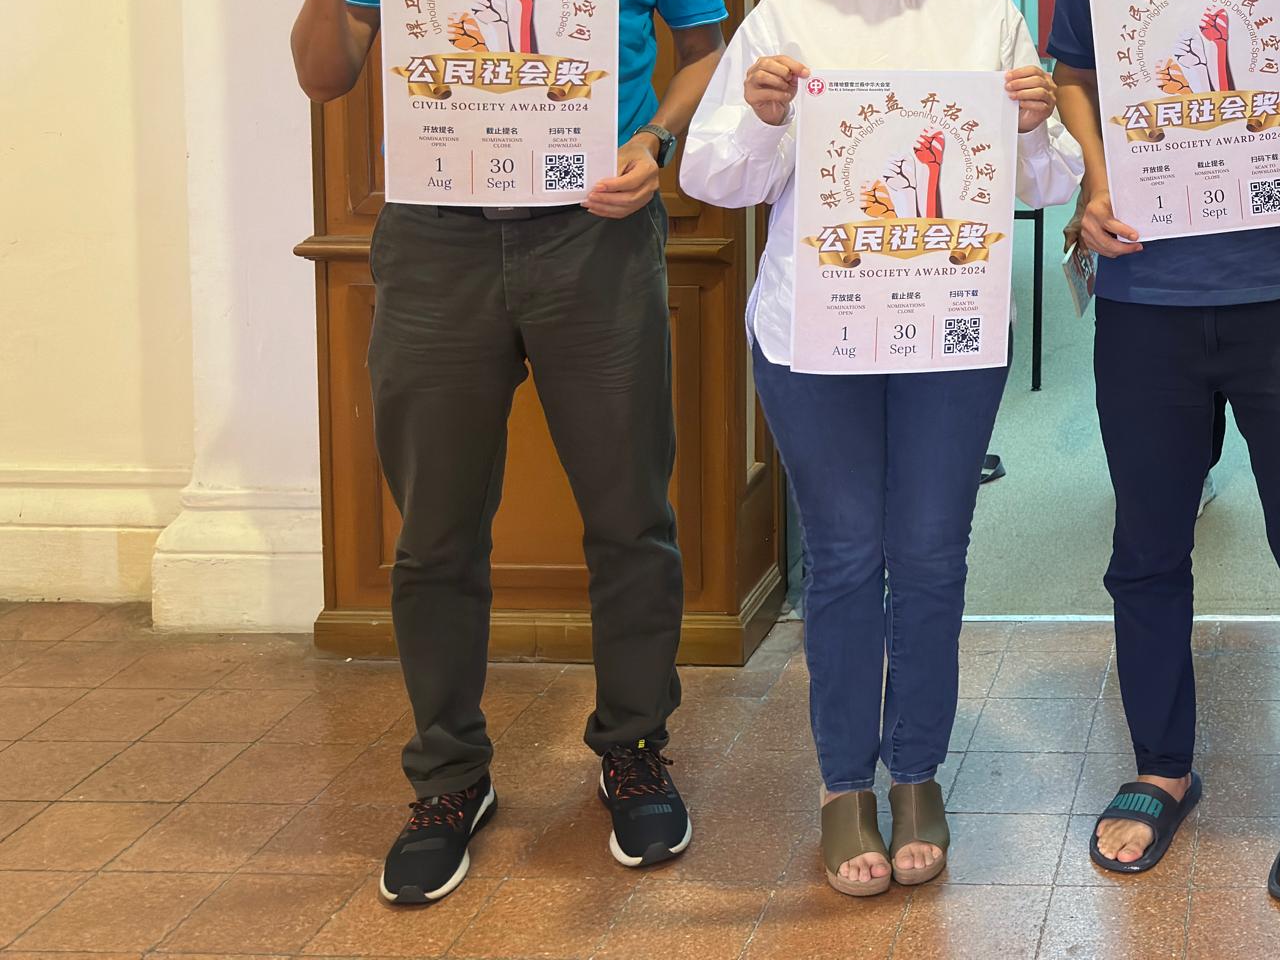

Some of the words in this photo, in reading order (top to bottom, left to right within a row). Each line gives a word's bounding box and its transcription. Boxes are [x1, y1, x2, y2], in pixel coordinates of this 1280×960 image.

[1148, 0, 1169, 21] Rights
[555, 10, 571, 37] Space
[1139, 20, 1151, 38] Civil
[1231, 4, 1258, 46] Democratic
[1248, 46, 1260, 73] Space
[1136, 40, 1152, 83] Upholding
[405, 56, 590, 86] 公民社会奖
[412, 101, 447, 110] CIVIL
[451, 102, 505, 111] SOCIETY
[510, 103, 556, 112] AWARD
[561, 103, 589, 112] 2024
[1122, 91, 1280, 130] 公民社会奖
[900, 109, 938, 124] Opening
[938, 118, 951, 130] Up
[422, 125, 455, 134] 开放提名
[486, 127, 518, 135] 截止提名
[549, 127, 581, 135] 扫码下载
[859, 117, 884, 138] Rights
[847, 137, 861, 156] Civil
[949, 126, 974, 171] Democratic
[1131, 145, 1162, 154] CIVIL
[1165, 139, 1212, 151] SOCIETY
[1215, 135, 1256, 146] AWARD
[436, 157, 442, 172] 1
[1197, 160, 1225, 169] 截止提名
[1251, 154, 1279, 163] 扫码下载
[490, 159, 514, 174] 30
[1142, 165, 1170, 174] 开放提名
[427, 177, 452, 190] Aug
[487, 178, 516, 191] Sept
[841, 157, 854, 204] Upholding
[958, 172, 973, 201] Space
[1156, 195, 1164, 209] 1
[1203, 190, 1225, 205] 30
[1151, 213, 1173, 224] Aug
[1202, 208, 1228, 219] Sept
[817, 223, 988, 252] 公民社会奖
[822, 270, 855, 279] CIVIL
[859, 269, 911, 277] SOCIETY
[915, 268, 957, 276] AWARD
[961, 266, 986, 275] 2024
[831, 293, 861, 302] 开放提名
[891, 292, 921, 300] 截止提名
[949, 290, 979, 298] 扫码下载
[842, 326, 848, 341] 1
[893, 324, 917, 340] 30
[832, 345, 856, 358] Aug
[889, 344, 916, 357] Sept
[1109, 793, 1164, 819] PUMA
